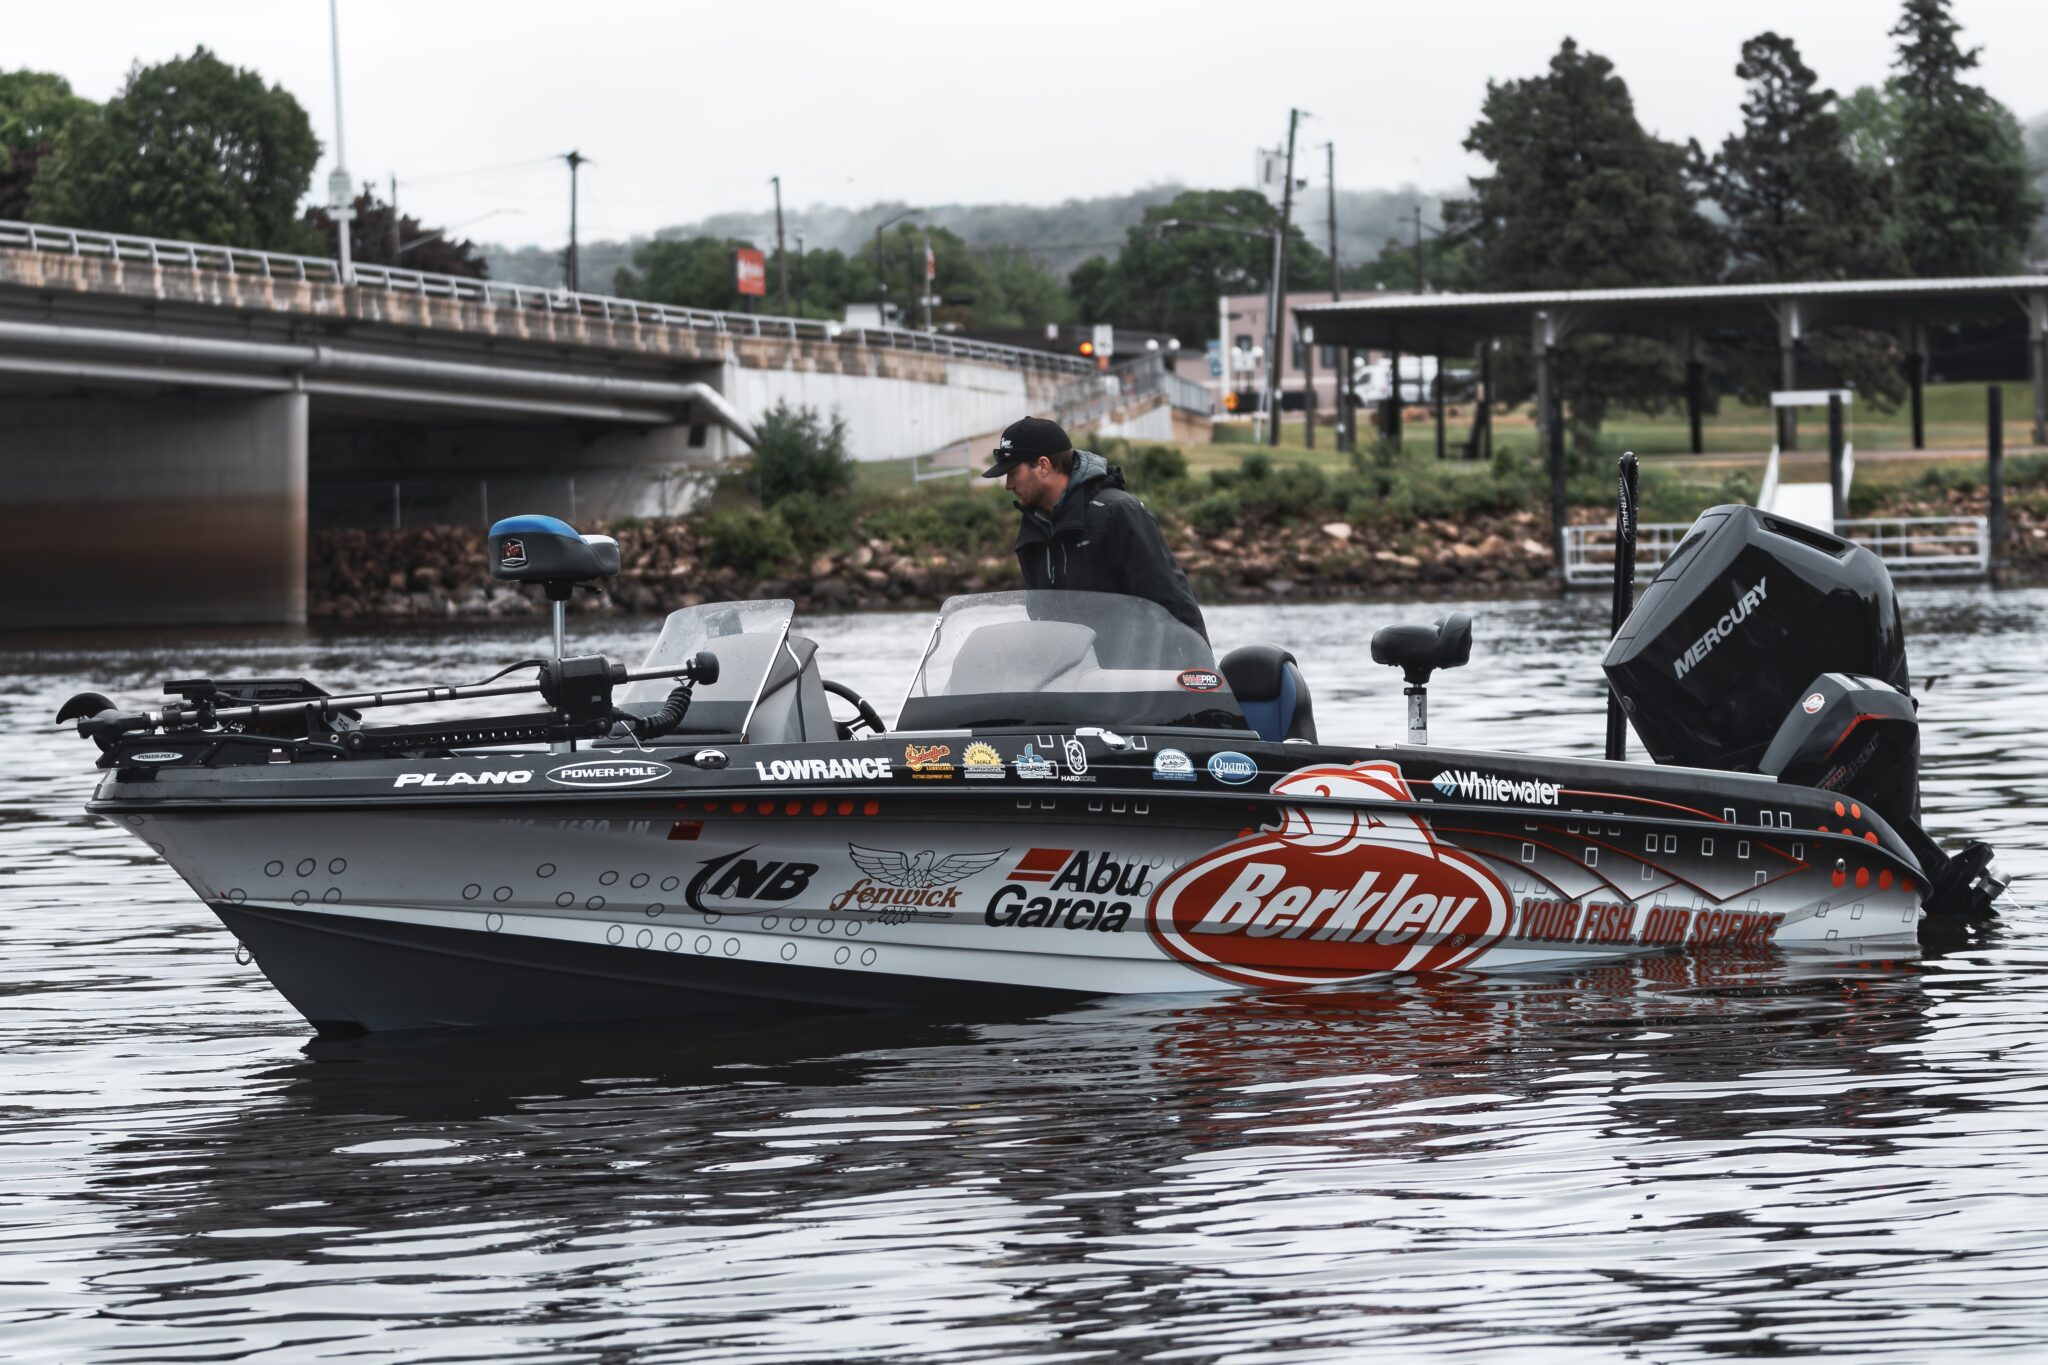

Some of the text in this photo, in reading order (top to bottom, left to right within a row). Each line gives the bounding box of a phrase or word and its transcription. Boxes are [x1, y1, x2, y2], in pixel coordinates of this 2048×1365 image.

[1673, 576, 1767, 679] MERCURY
[393, 771, 533, 787] PLANO
[560, 767, 657, 778] POWER-POLE
[755, 758, 893, 781] LOWRANCE
[1214, 757, 1251, 774] Quam's
[1454, 770, 1561, 805] Whitewater
[1049, 850, 1150, 896] Abu
[829, 878, 963, 911] fenwick
[984, 884, 1132, 933] Garcia
[1189, 862, 1479, 971] Berkley
[1516, 898, 1582, 941] YOUR
[1640, 906, 1691, 947] OUR
[1690, 910, 1785, 947] SCIENCE
